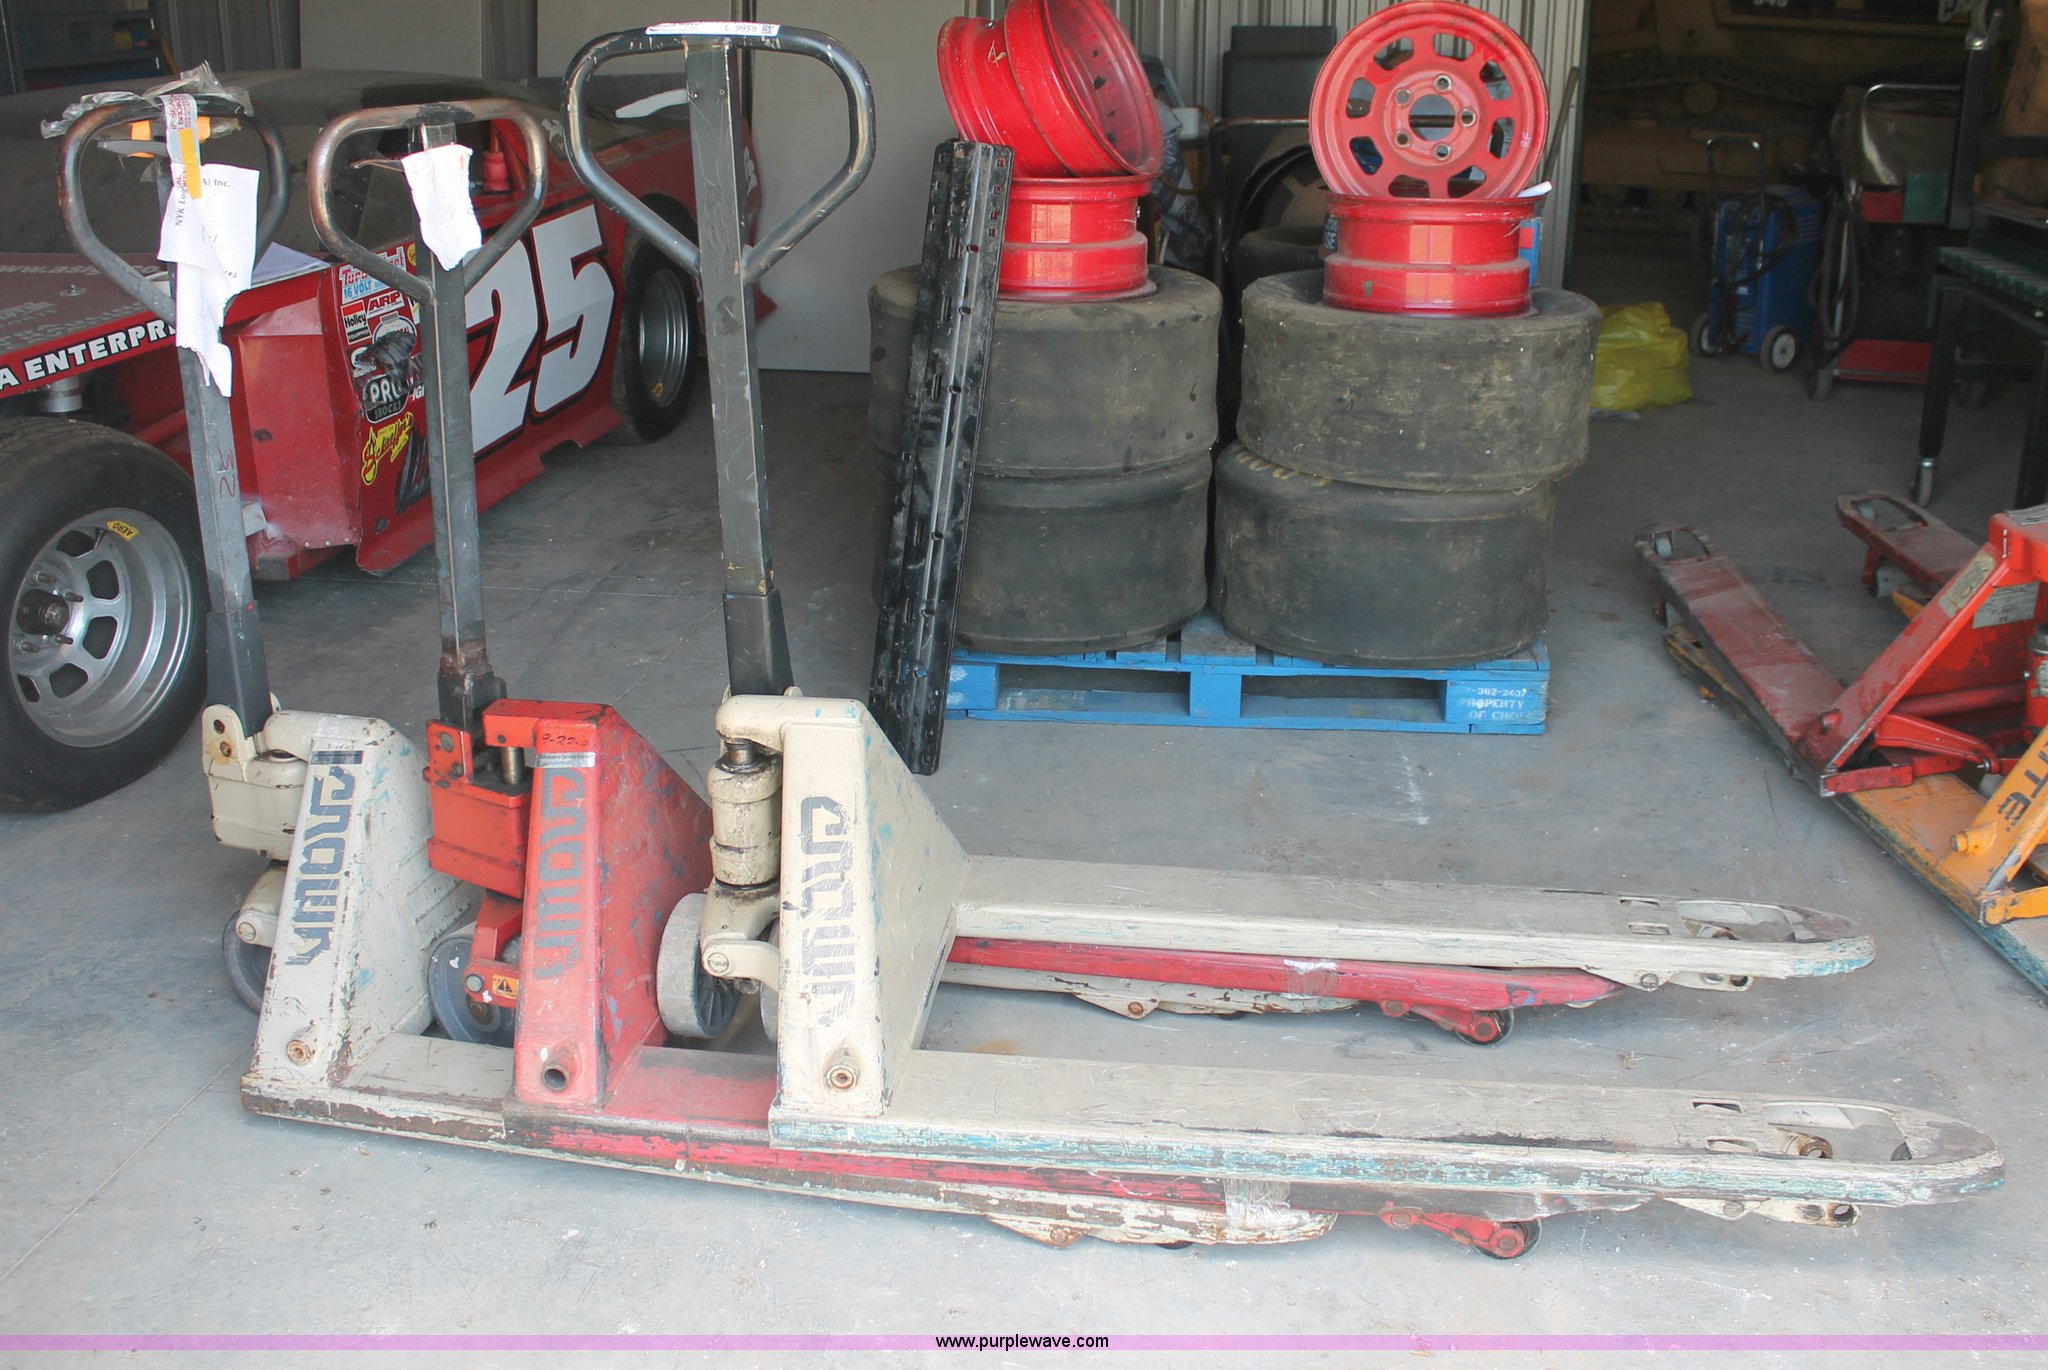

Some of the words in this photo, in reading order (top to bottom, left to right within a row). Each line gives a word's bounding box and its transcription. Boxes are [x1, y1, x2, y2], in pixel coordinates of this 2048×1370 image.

[214, 178, 231, 188] Inc.
[174, 207, 186, 227] NYK
[343, 288, 353, 299] 16
[353, 280, 372, 294] VOLT
[368, 291, 401, 312] ARP
[344, 313, 367, 329] Holley
[464, 204, 615, 454] 25
[1460, 697, 1525, 710] PROPERTY
[1469, 710, 1487, 720] OF
